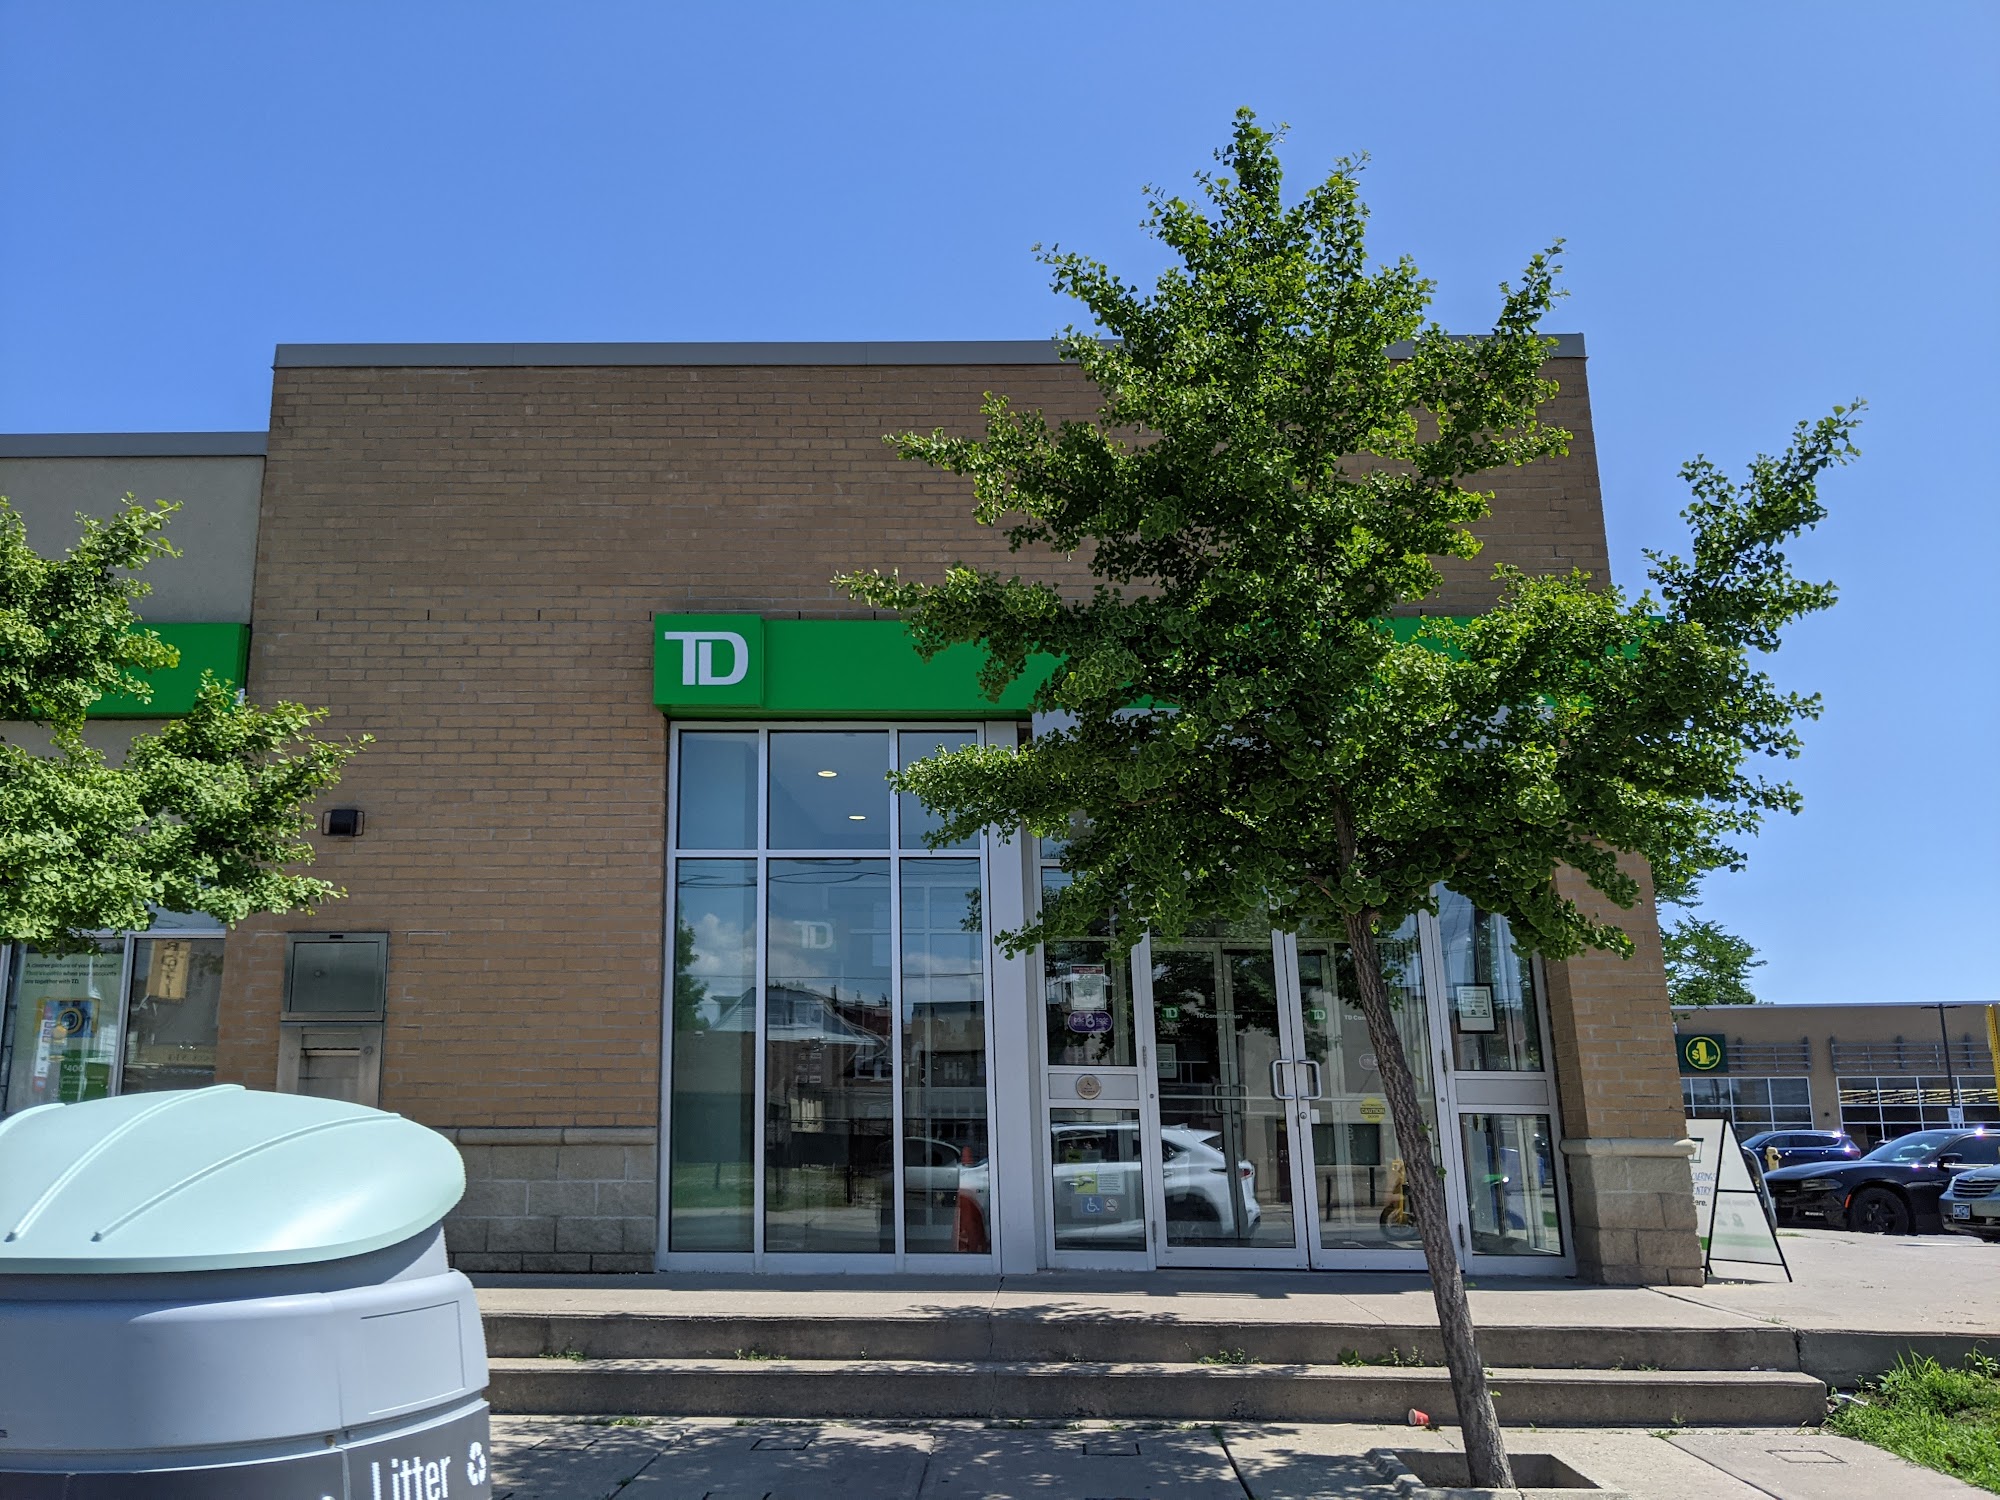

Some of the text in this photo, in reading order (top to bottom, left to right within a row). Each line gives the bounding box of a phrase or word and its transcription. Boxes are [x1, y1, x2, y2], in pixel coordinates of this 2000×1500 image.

[664, 631, 749, 685] TD
[793, 920, 834, 949] TD
[1162, 1007, 1178, 1019] TD
[1311, 1009, 1326, 1020] TD
[371, 1456, 451, 1500] Litter
